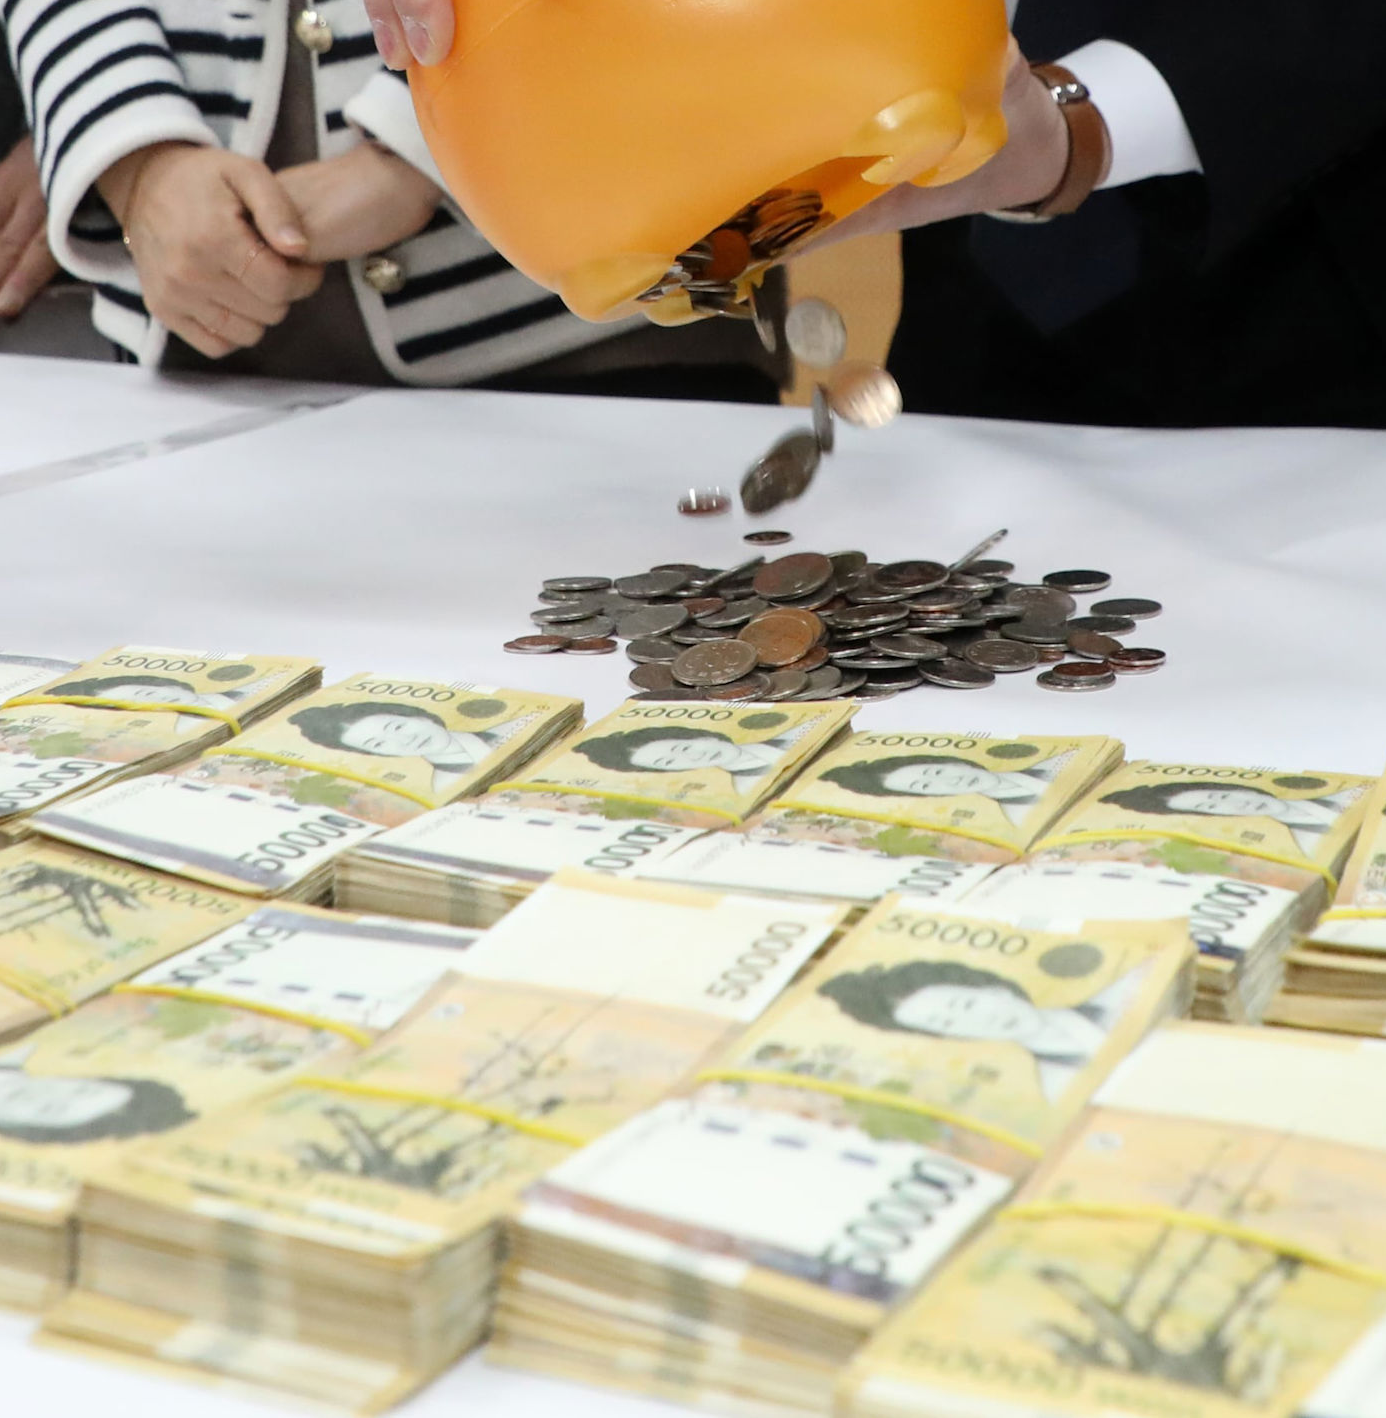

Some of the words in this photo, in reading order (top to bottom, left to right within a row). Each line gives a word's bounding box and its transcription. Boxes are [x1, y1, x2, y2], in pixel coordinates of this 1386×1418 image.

[102, 654, 208, 674] 50000
[343, 681, 456, 703] 50000
[619, 705, 734, 722] 50000
[854, 734, 978, 751] 50000
[1134, 764, 1264, 779] 50000
[235, 813, 367, 874] 50000
[583, 823, 684, 876] 0000
[876, 911, 1030, 956] 50000
[705, 920, 808, 1002] 50000
